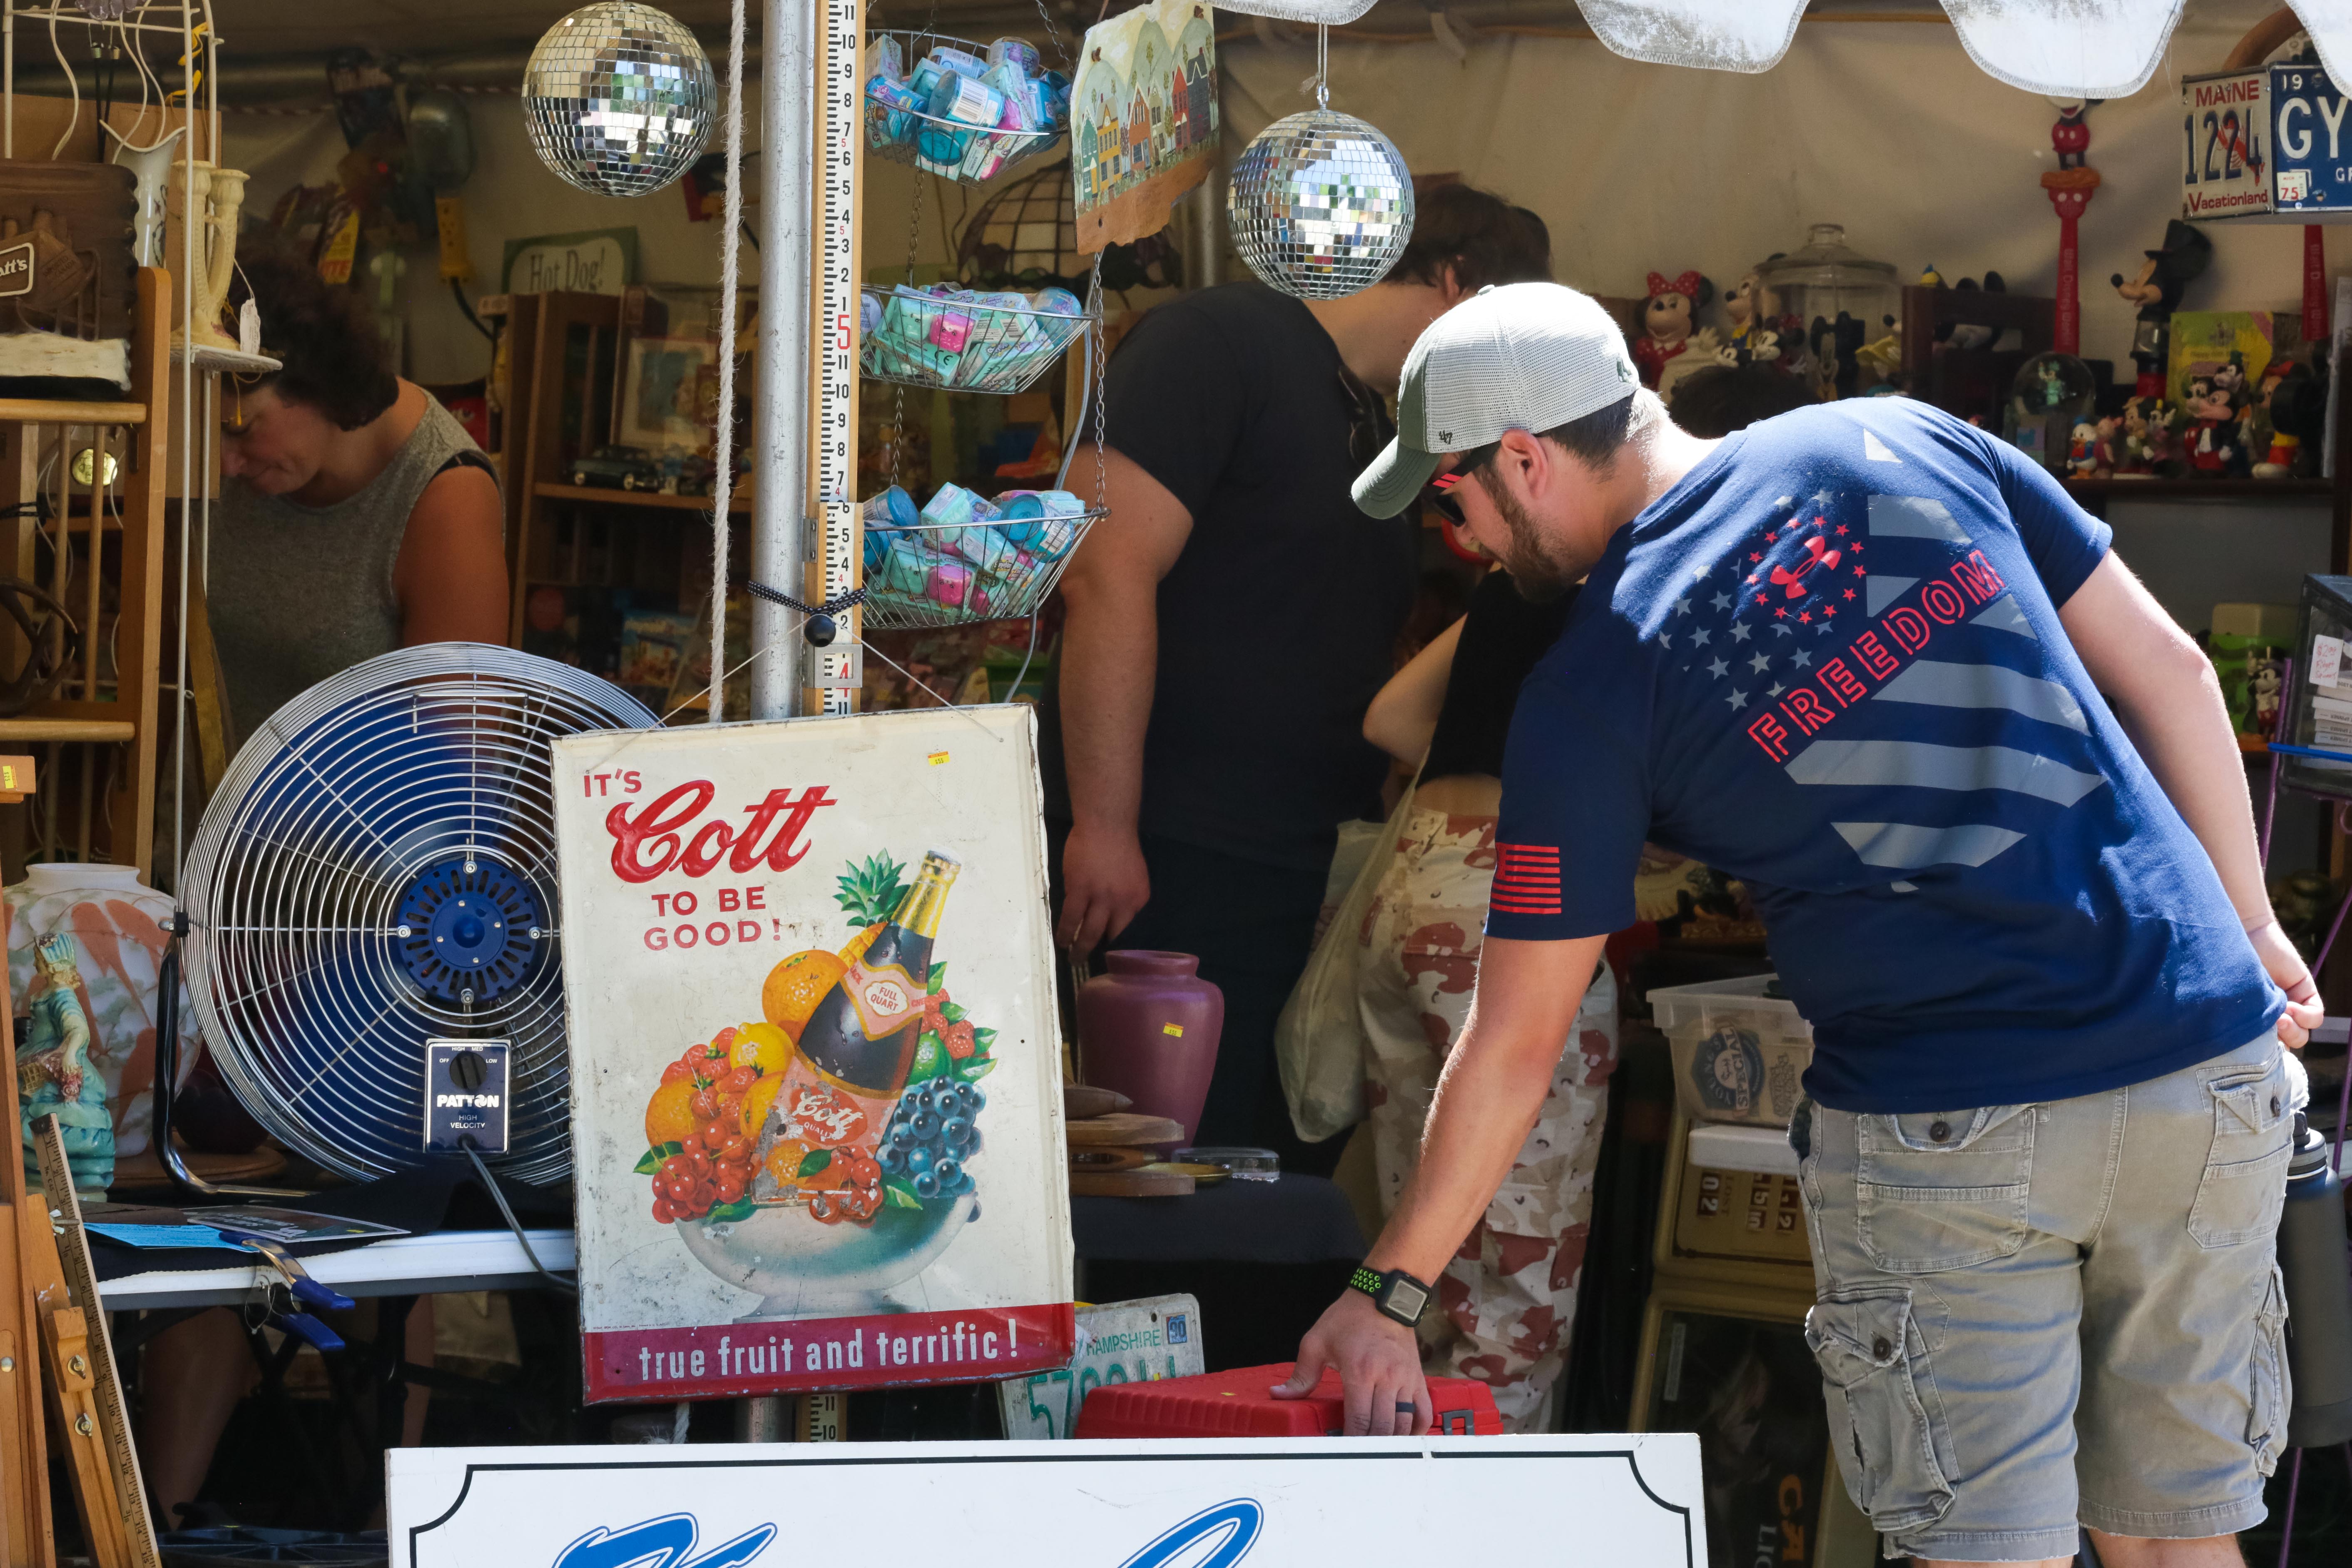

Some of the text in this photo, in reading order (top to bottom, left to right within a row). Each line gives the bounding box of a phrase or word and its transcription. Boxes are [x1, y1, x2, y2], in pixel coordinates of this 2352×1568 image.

[845, 5, 855, 20] 11
[842, 35, 856, 49] 10
[844, 64, 852, 78] 9
[2282, 74, 2303, 91] 19
[844, 93, 851, 107] 8
[2196, 79, 2260, 107] MAINE
[844, 122, 851, 137] 7
[841, 138, 846, 147] 5
[2185, 107, 2262, 185] 1224
[843, 151, 851, 166] 6
[842, 180, 850, 195] 5
[2281, 187, 2299, 200] 75
[2188, 189, 2268, 212] Vacationland
[842, 209, 850, 224] 4
[839, 225, 844, 235] 5
[841, 238, 849, 253] 3
[530, 246, 605, 294] Hot Dog!
[841, 267, 849, 282] 2
[842, 297, 846, 311] 1
[837, 315, 850, 350] 5
[839, 355, 848, 370] 11
[836, 384, 849, 398] 10
[838, 413, 846, 428] 9
[837, 442, 845, 457] 8
[838, 471, 844, 485] 7
[835, 487, 840, 496] 4
[842, 528, 849, 543] 5
[841, 557, 849, 572] 4
[839, 574, 844, 582] 4
[840, 615, 848, 630] 2
[1747, 549, 2005, 763] FREEDOM
[838, 702, 848, 715] 11
[584, 768, 642, 797] IT'S
[605, 779, 839, 884] Cott
[651, 886, 766, 917] TO BE
[879, 986, 897, 1001] FULL
[870, 994, 899, 1011] QUART
[1724, 1028, 1749, 1107] SPECIAL
[437, 1094, 499, 1108] PATTON
[1169, 1320, 1187, 1339] 90
[639, 1318, 1018, 1381] true fruit and terrific!
[1087, 1329, 1161, 1356] HAMPSHIRE
[825, 1396, 834, 1411] 11
[823, 1425, 836, 1440] 10
